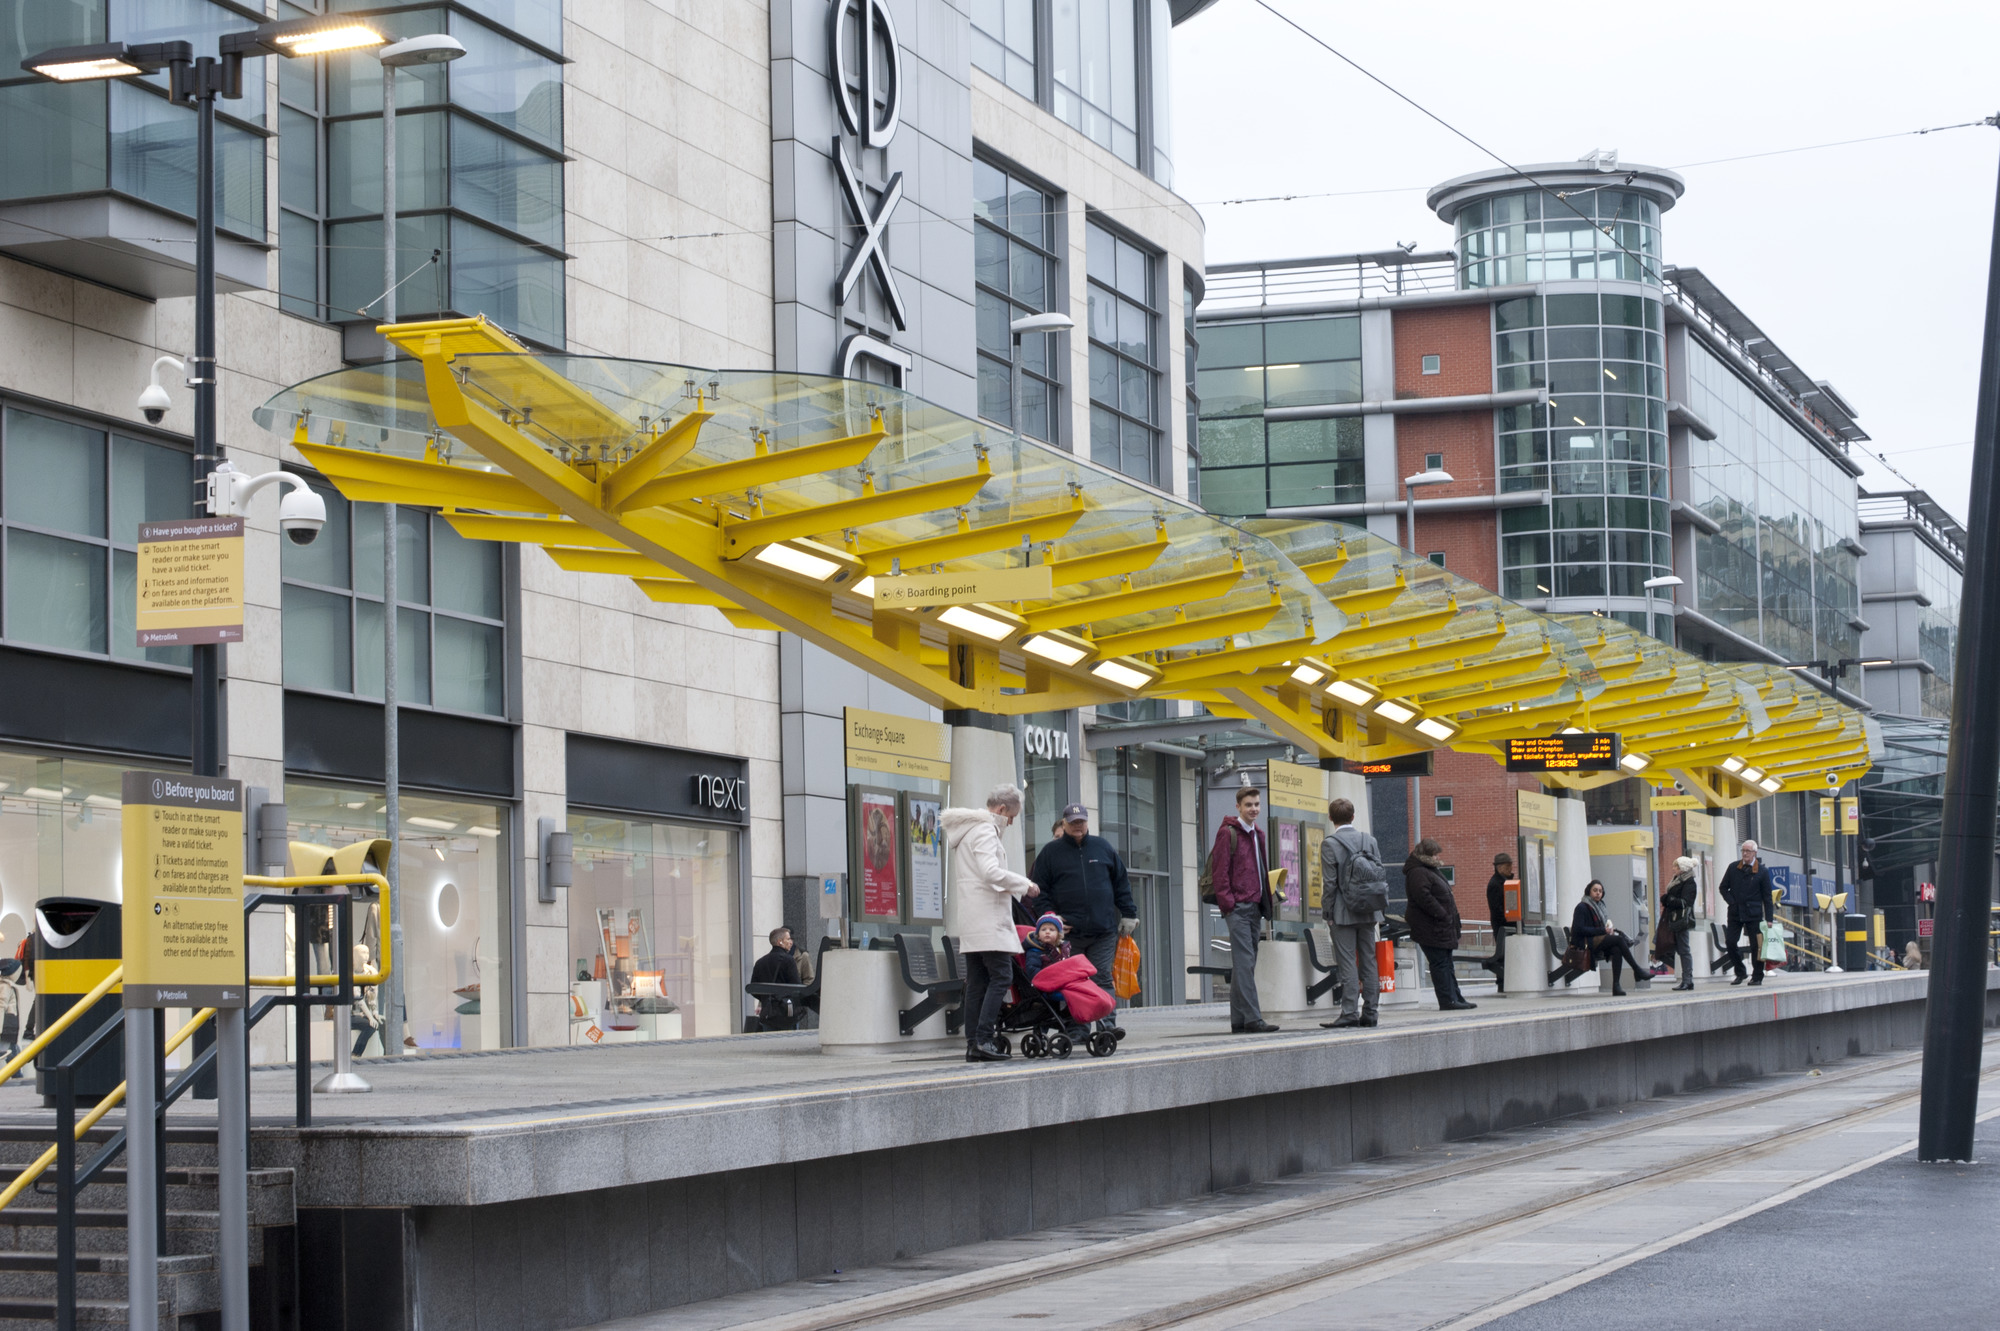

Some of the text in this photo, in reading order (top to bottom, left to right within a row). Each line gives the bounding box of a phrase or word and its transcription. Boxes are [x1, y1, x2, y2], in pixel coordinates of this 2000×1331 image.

[152, 522, 238, 537] Have you bought a ticket?
[152, 542, 220, 553] Touch in at the smart
[182, 554, 200, 562] make
[216, 553, 229, 561] you
[152, 566, 167, 574] have
[174, 565, 190, 573] valid
[190, 563, 212, 572] ticket.
[152, 575, 229, 587] Tickets and information
[161, 588, 178, 596] fares
[178, 587, 191, 595] and
[192, 585, 218, 595] charges
[218, 585, 230, 593] are
[907, 584, 977, 598] Boarding point
[151, 600, 181, 608] available
[191, 598, 203, 606] the
[203, 596, 235, 606] platform.
[150, 632, 178, 642] Metrolink
[854, 721, 906, 747] Exchange Square
[1025, 724, 1071, 761] COSTA
[165, 781, 235, 803] Before you board
[699, 774, 747, 811] next
[162, 810, 221, 824] Touch in at the smart
[162, 825, 229, 840] reader or make sure you
[162, 838, 176, 848] have
[181, 840, 195, 849] valid
[195, 841, 214, 850] ticket.
[162, 854, 229, 868] Tickets and information
[162, 869, 229, 884] on fares and charges are
[162, 883, 234, 896] available on the platform.
[163, 919, 229, 933] An alternative step free
[163, 933, 229, 944] route is available at the
[163, 947, 236, 959] other end of the platform.
[163, 991, 188, 1000] Metrolink
